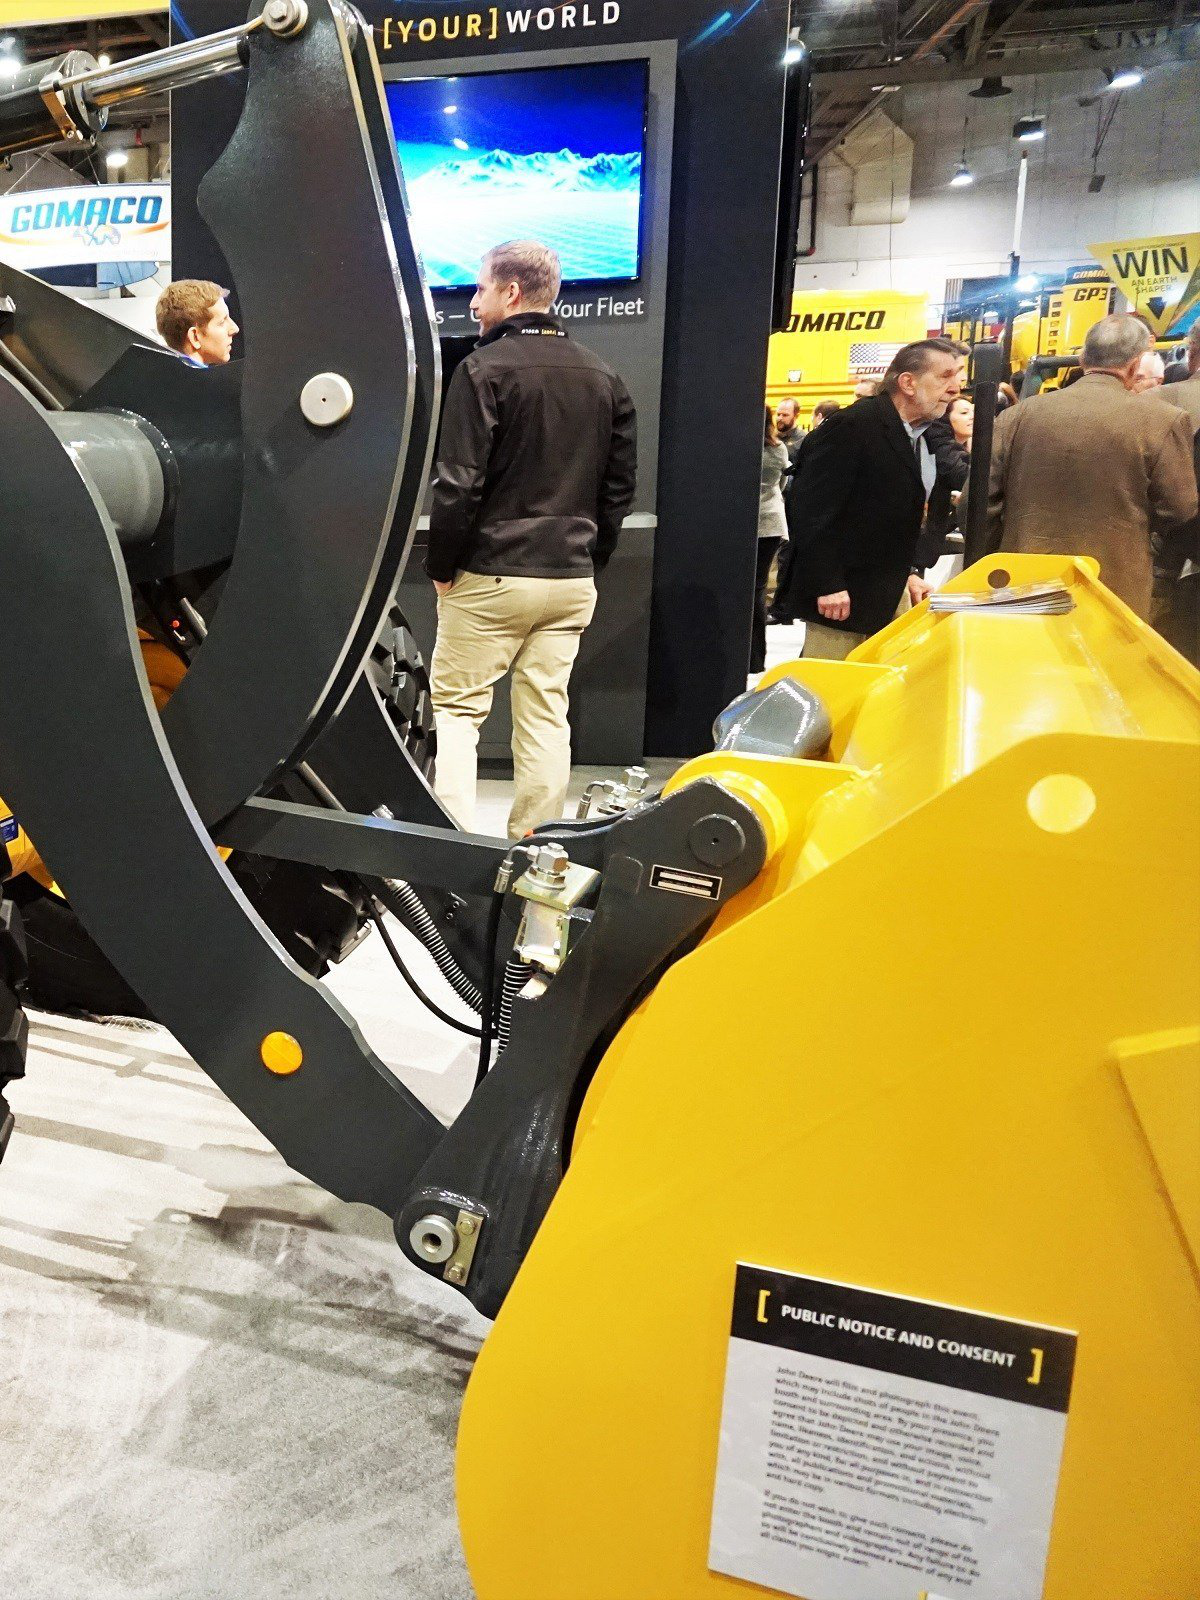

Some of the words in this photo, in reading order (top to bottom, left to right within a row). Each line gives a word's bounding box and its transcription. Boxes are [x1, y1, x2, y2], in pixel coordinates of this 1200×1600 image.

[506, 1, 620, 33] WORLD
[11, 195, 163, 233] GOMACO
[1112, 246, 1188, 278] WIN
[552, 299, 593, 318] Your
[597, 296, 645, 316] Fleet
[782, 311, 886, 333] OMACO
[781, 1304, 835, 1328] PUBLIC
[838, 1317, 896, 1341] NOTICE
[899, 1328, 935, 1350] AND
[937, 1339, 1017, 1367] CONSENT
